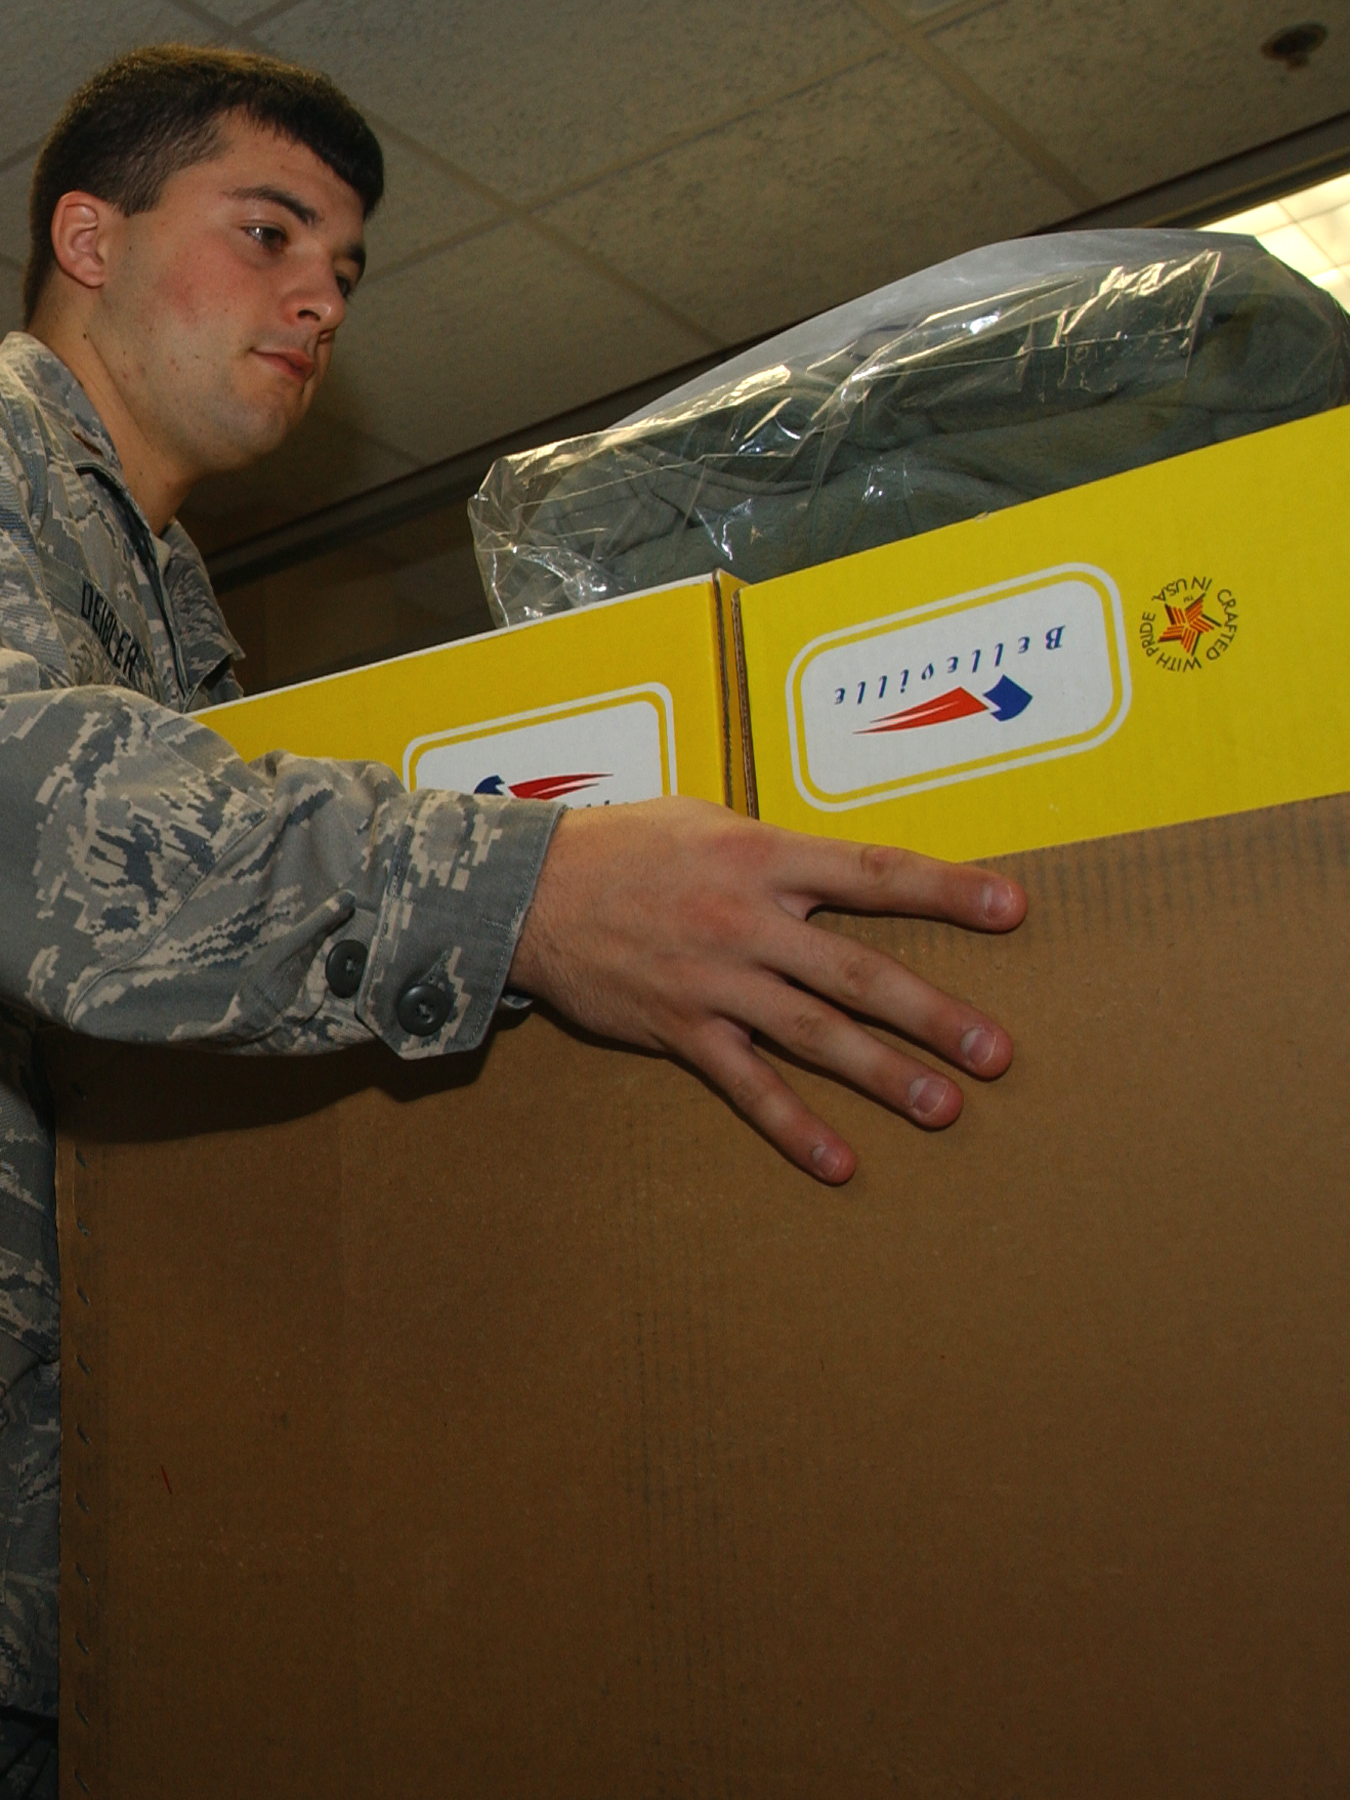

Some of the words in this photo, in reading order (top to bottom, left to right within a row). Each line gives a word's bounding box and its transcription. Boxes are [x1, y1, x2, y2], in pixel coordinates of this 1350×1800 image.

[1151, 578, 1187, 602] USA
[1191, 576, 1212, 592] IN
[1139, 611, 1159, 657] PRIDE
[1206, 588, 1238, 661] CRAFTED
[834, 625, 1065, 705] Belleville
[1156, 652, 1202, 673] WITH
